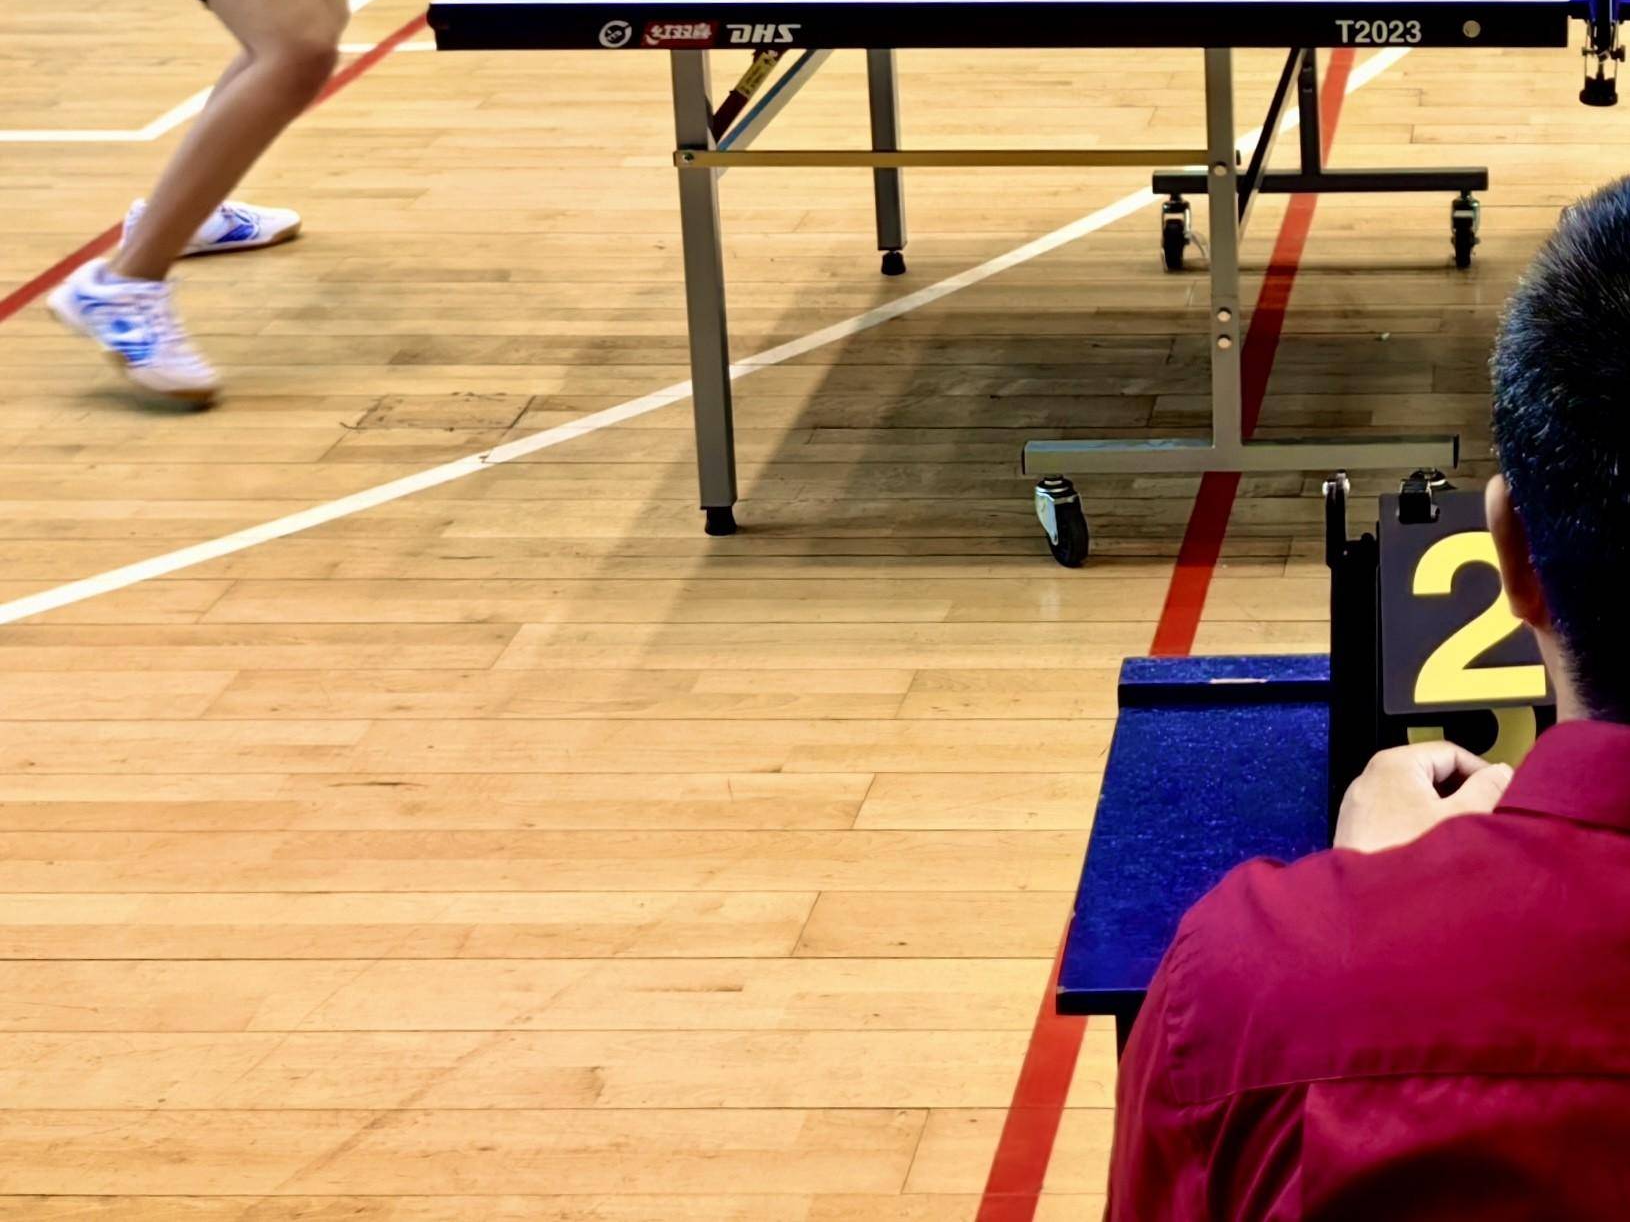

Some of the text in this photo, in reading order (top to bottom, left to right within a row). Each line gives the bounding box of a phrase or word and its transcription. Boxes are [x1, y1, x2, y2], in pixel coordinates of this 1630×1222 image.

[726, 23, 802, 44] DHS
[1335, 19, 1422, 44] T2023
[1412, 530, 1547, 704] 2
